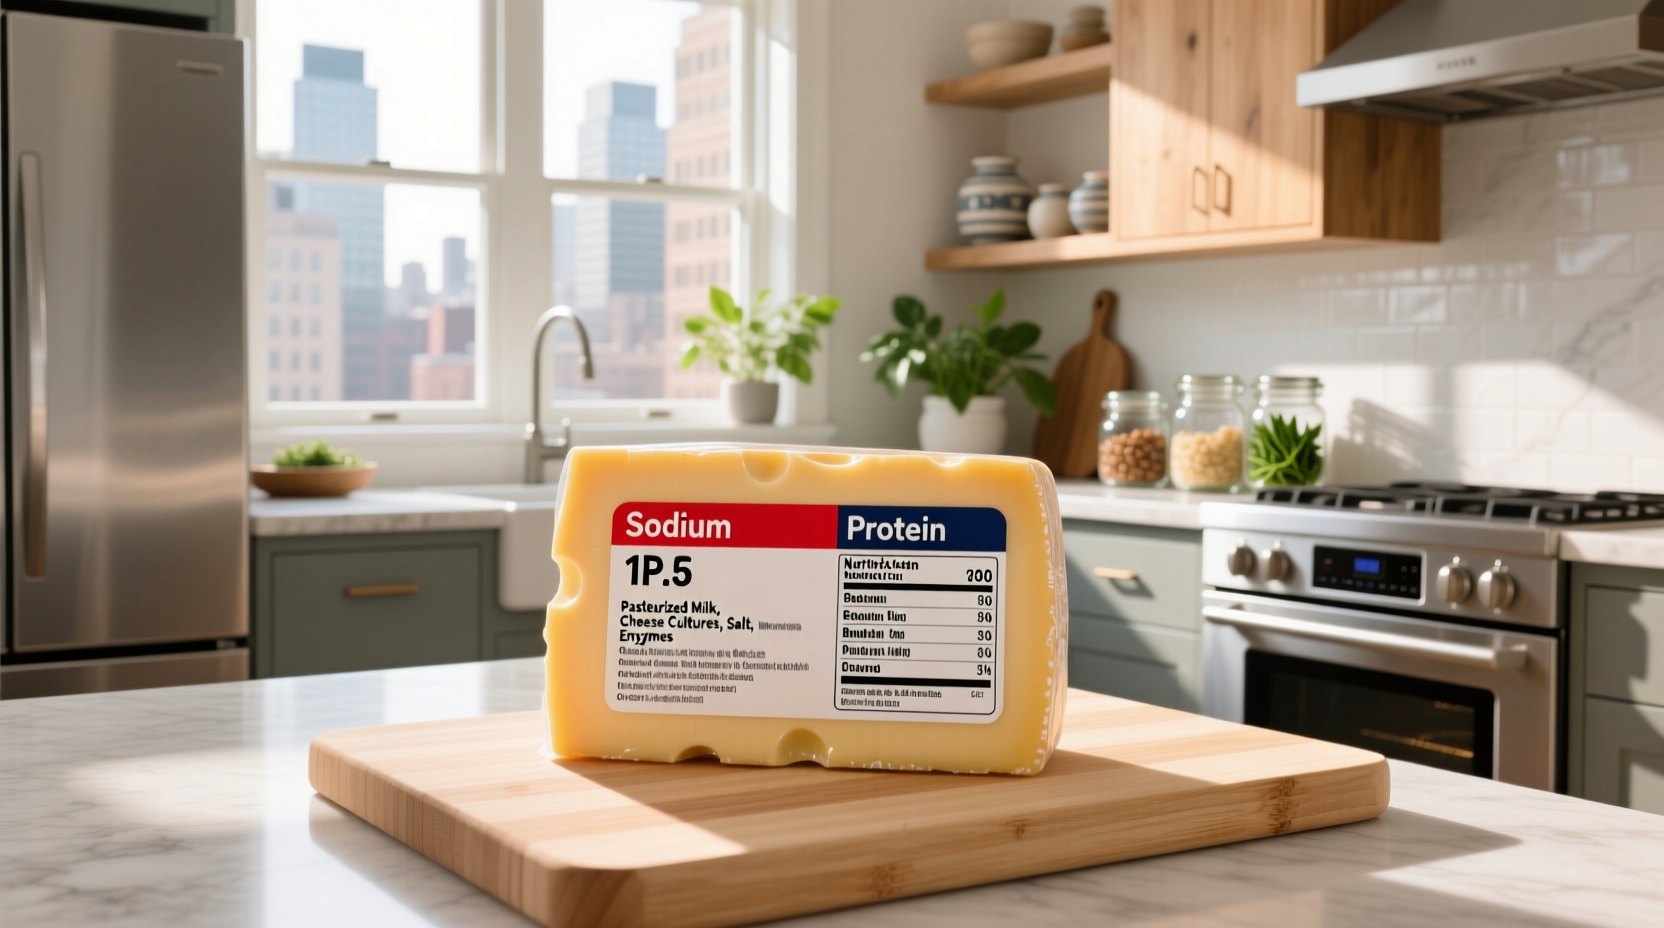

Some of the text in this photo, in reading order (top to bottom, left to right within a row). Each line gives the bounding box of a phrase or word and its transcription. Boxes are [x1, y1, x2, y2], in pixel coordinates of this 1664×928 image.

[625, 511, 731, 539] Sodium
[847, 515, 946, 542] Protein
[625, 554, 693, 587] 1P.5
[691, 600, 721, 616] Milk,
[667, 615, 723, 633] Cultures,
[727, 615, 754, 633] Salt,
